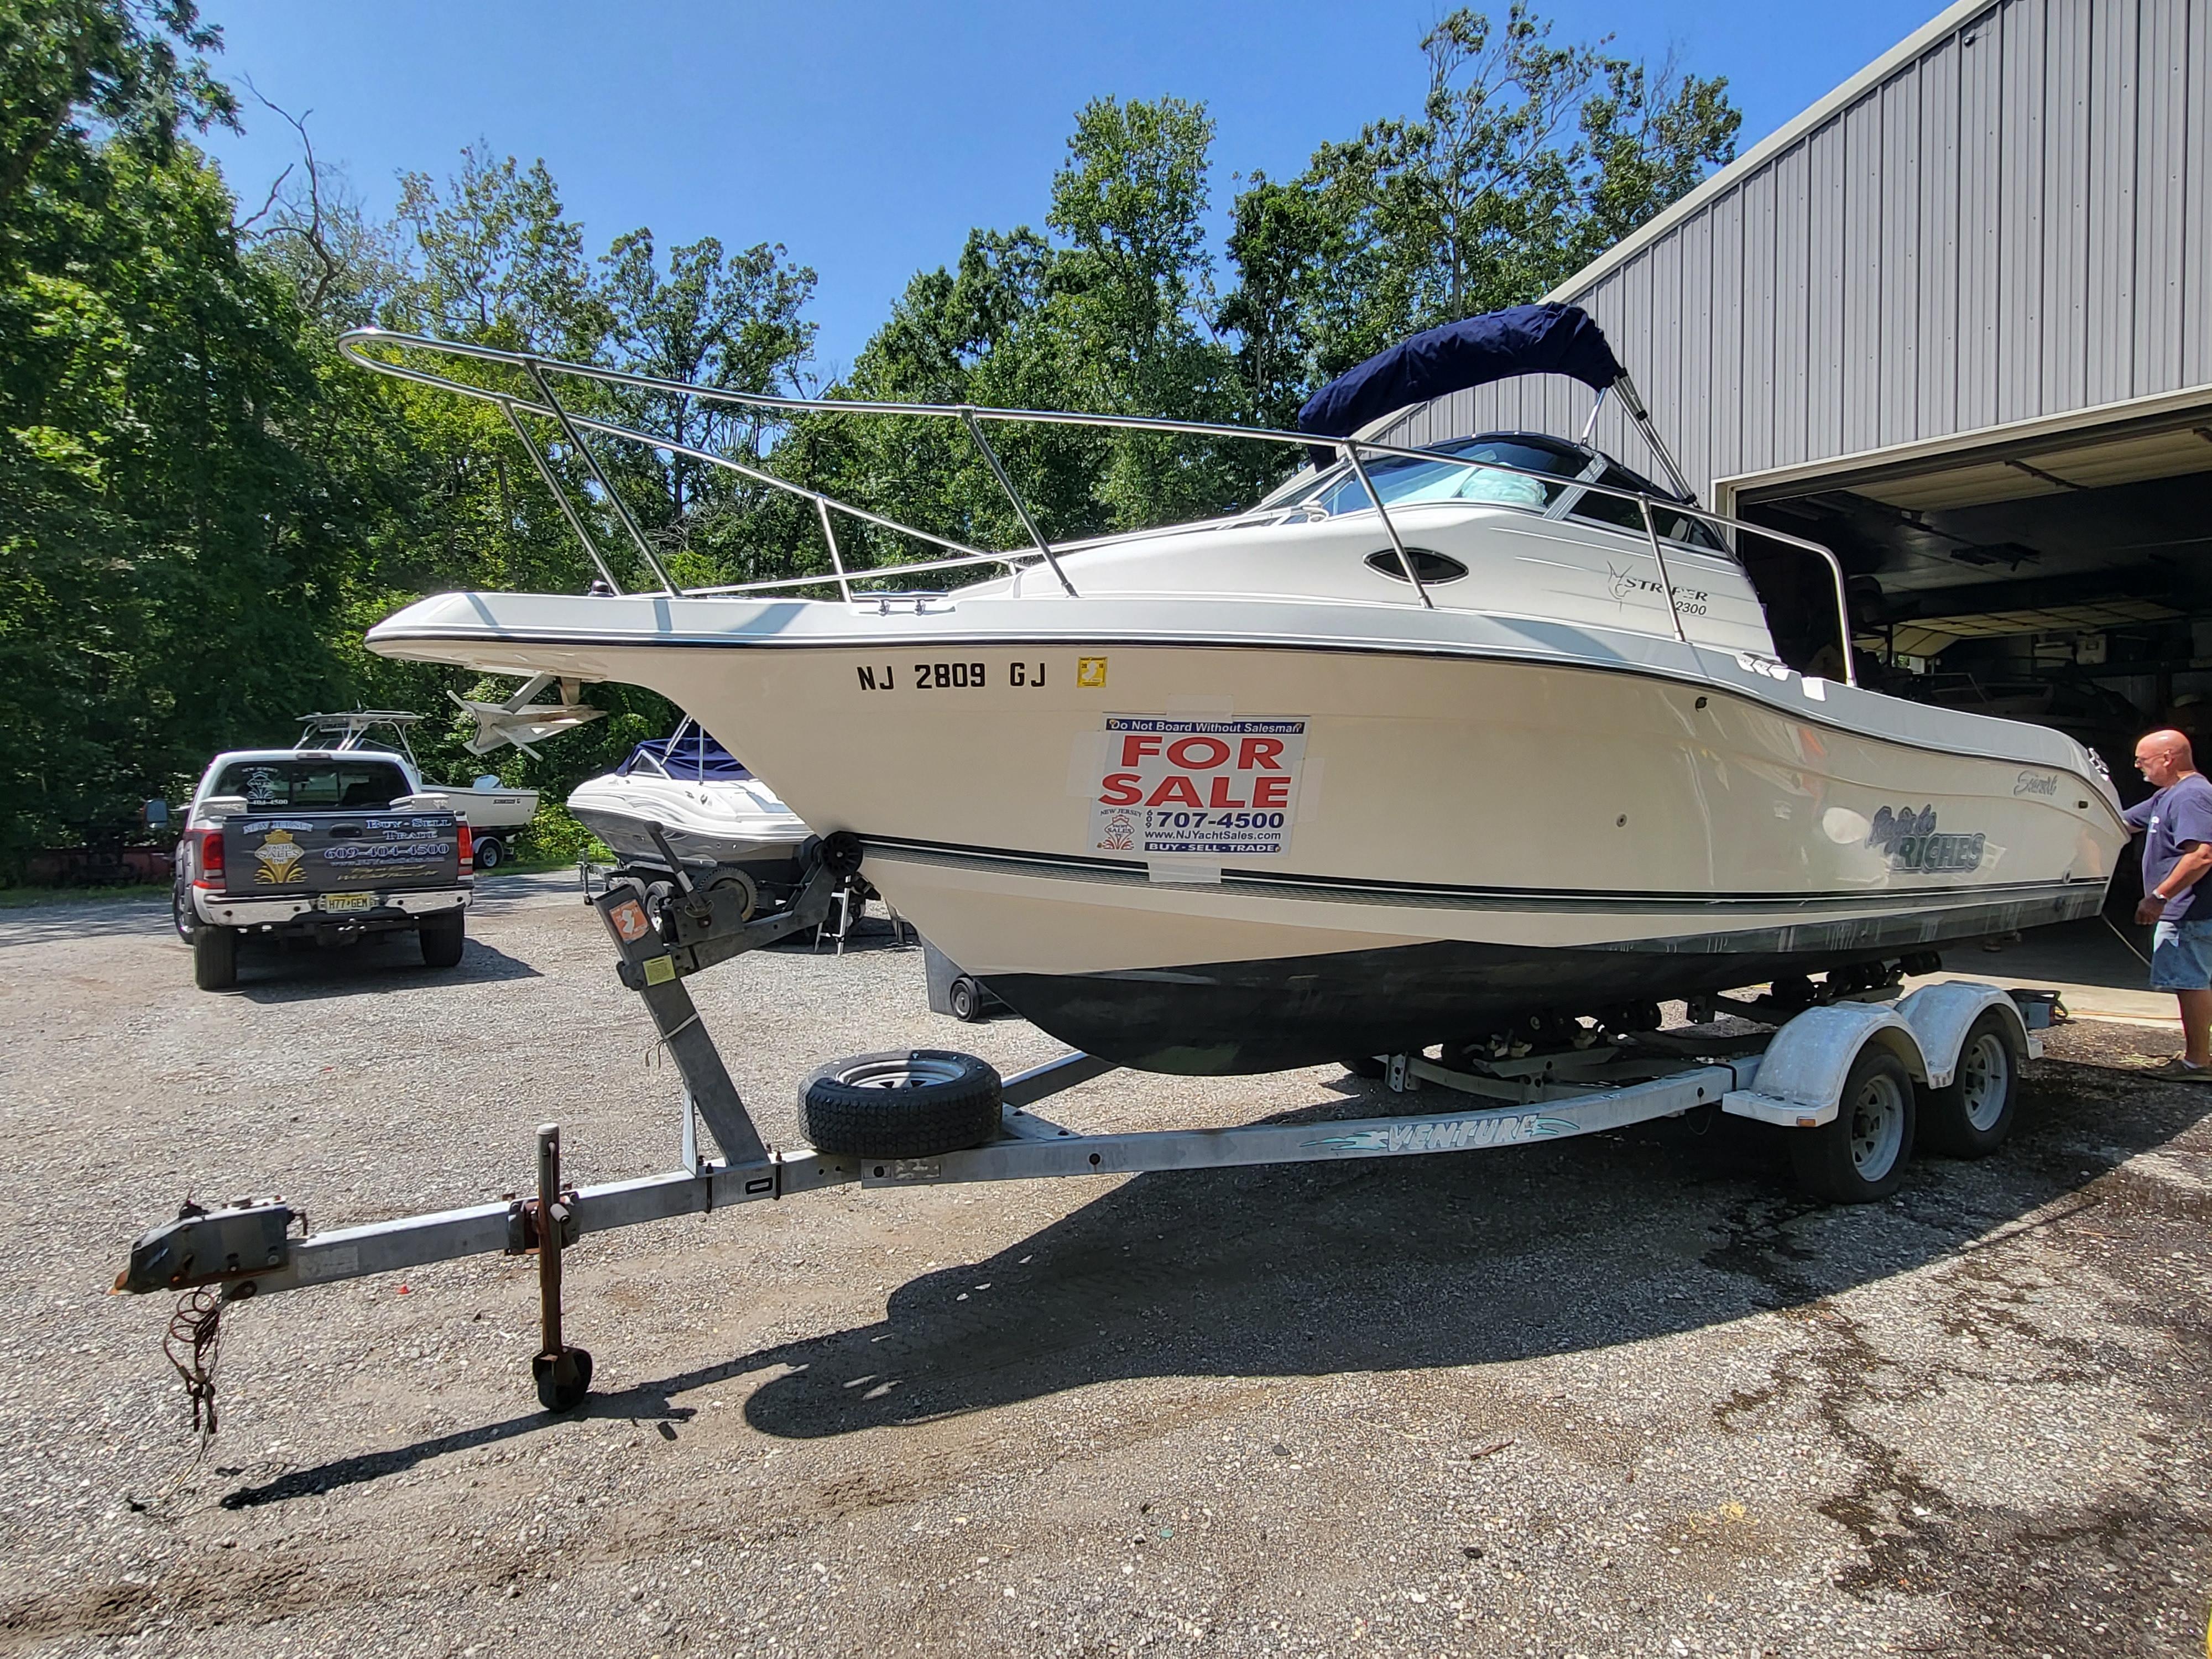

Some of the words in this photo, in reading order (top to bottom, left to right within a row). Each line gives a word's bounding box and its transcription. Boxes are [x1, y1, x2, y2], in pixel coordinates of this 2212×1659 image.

[1624, 578, 1708, 602] STRPER
[1675, 601, 1707, 615] 2300
[856, 665, 894, 690] NJ
[914, 663, 985, 689] 2809
[1009, 662, 1046, 687] GJ
[1111, 720, 1128, 730] Do
[1131, 721, 1153, 731] Not
[1156, 722, 1192, 731] Board
[1196, 722, 1241, 732] Without
[1244, 723, 1300, 733] Salesman
[1121, 735, 1285, 770] FOR
[1098, 773, 1292, 808] SALE
[1117, 808, 1142, 817] JERSEY
[1157, 812, 1284, 828] 707-4500
[1145, 831, 1281, 839] www.NJYachtSales.com
[324, 843, 450, 859] 609-404-4500
[1893, 833, 1986, 873] RICHES
[1388, 1113, 1540, 1152] VENTURE
